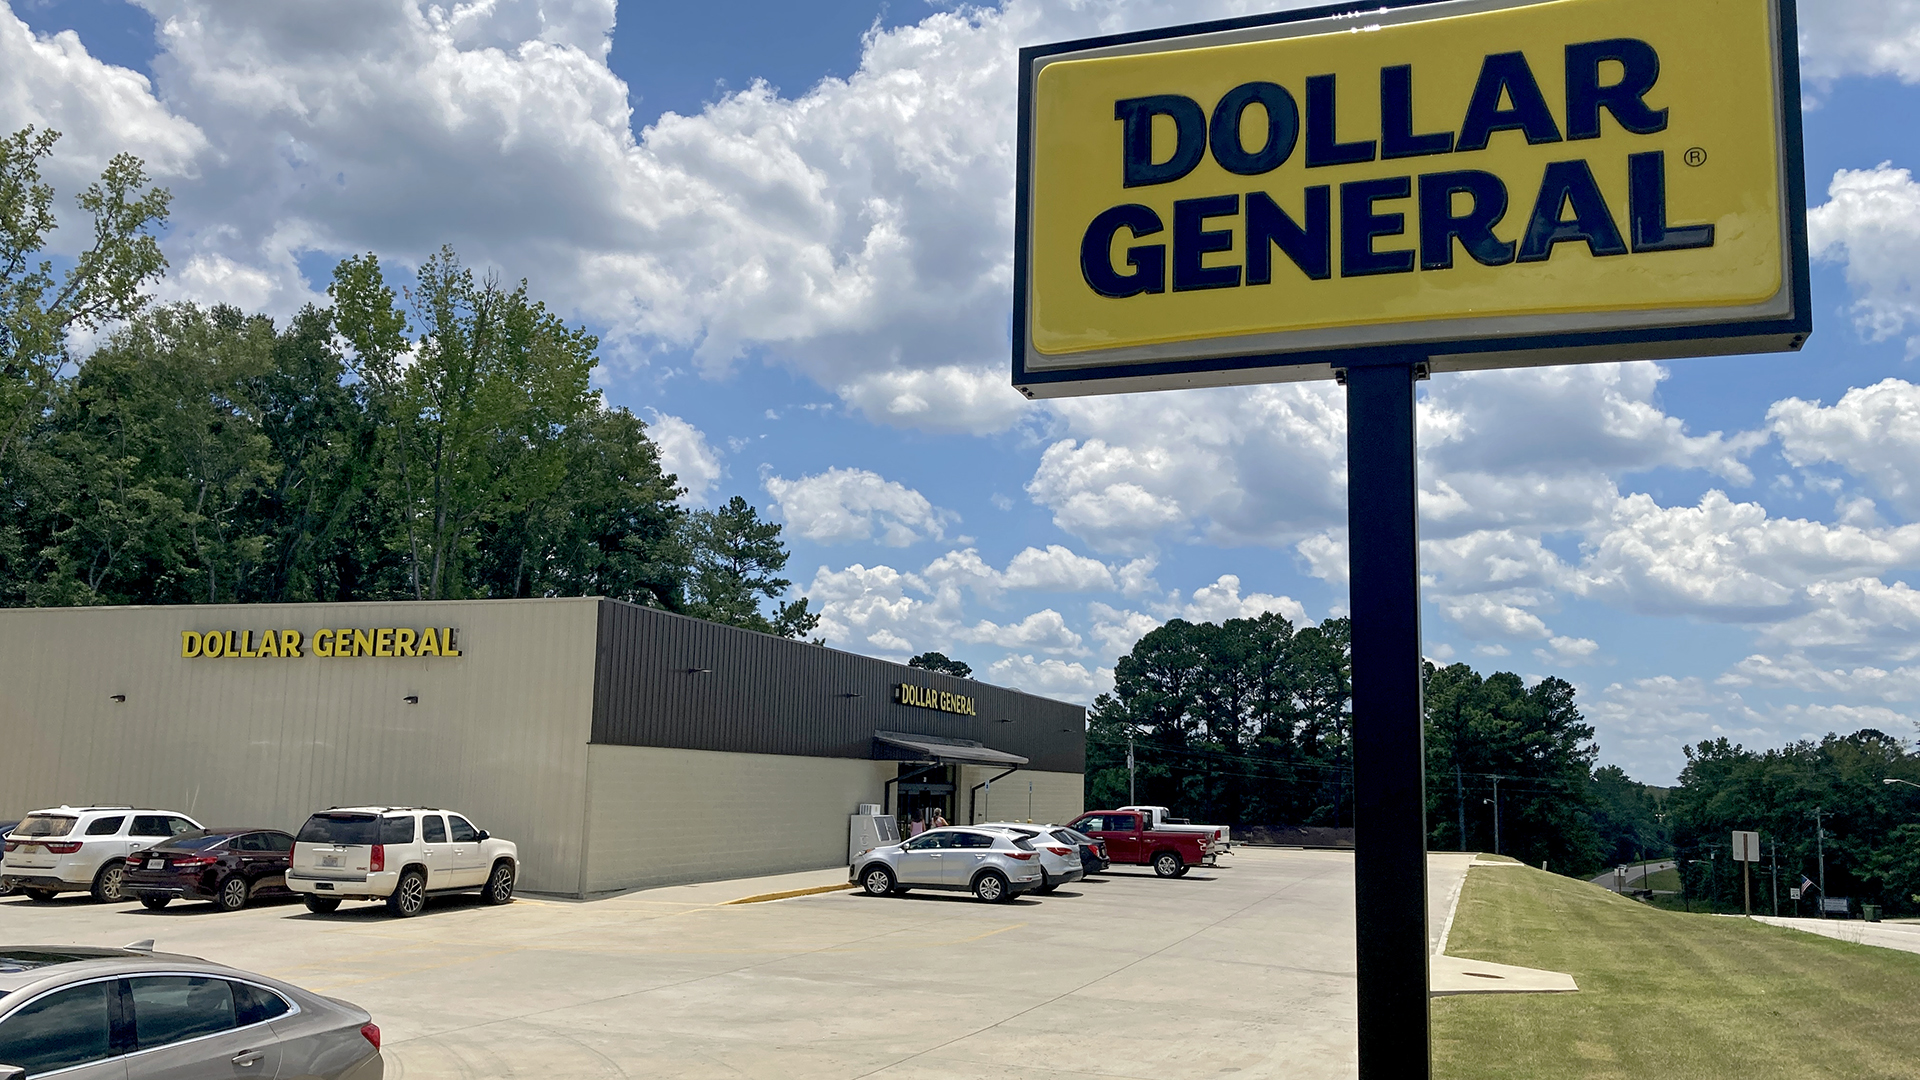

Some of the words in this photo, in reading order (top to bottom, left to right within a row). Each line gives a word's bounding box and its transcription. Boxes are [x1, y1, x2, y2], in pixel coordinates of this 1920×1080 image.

[1114, 38, 1669, 189] DOLLAR
[1080, 150, 1715, 298] GENERAL
[181, 630, 304, 658] DOLLAR
[312, 627, 462, 657] GENERAL
[902, 683, 938, 709] DOLLAR
[940, 691, 976, 716] GENERAL
